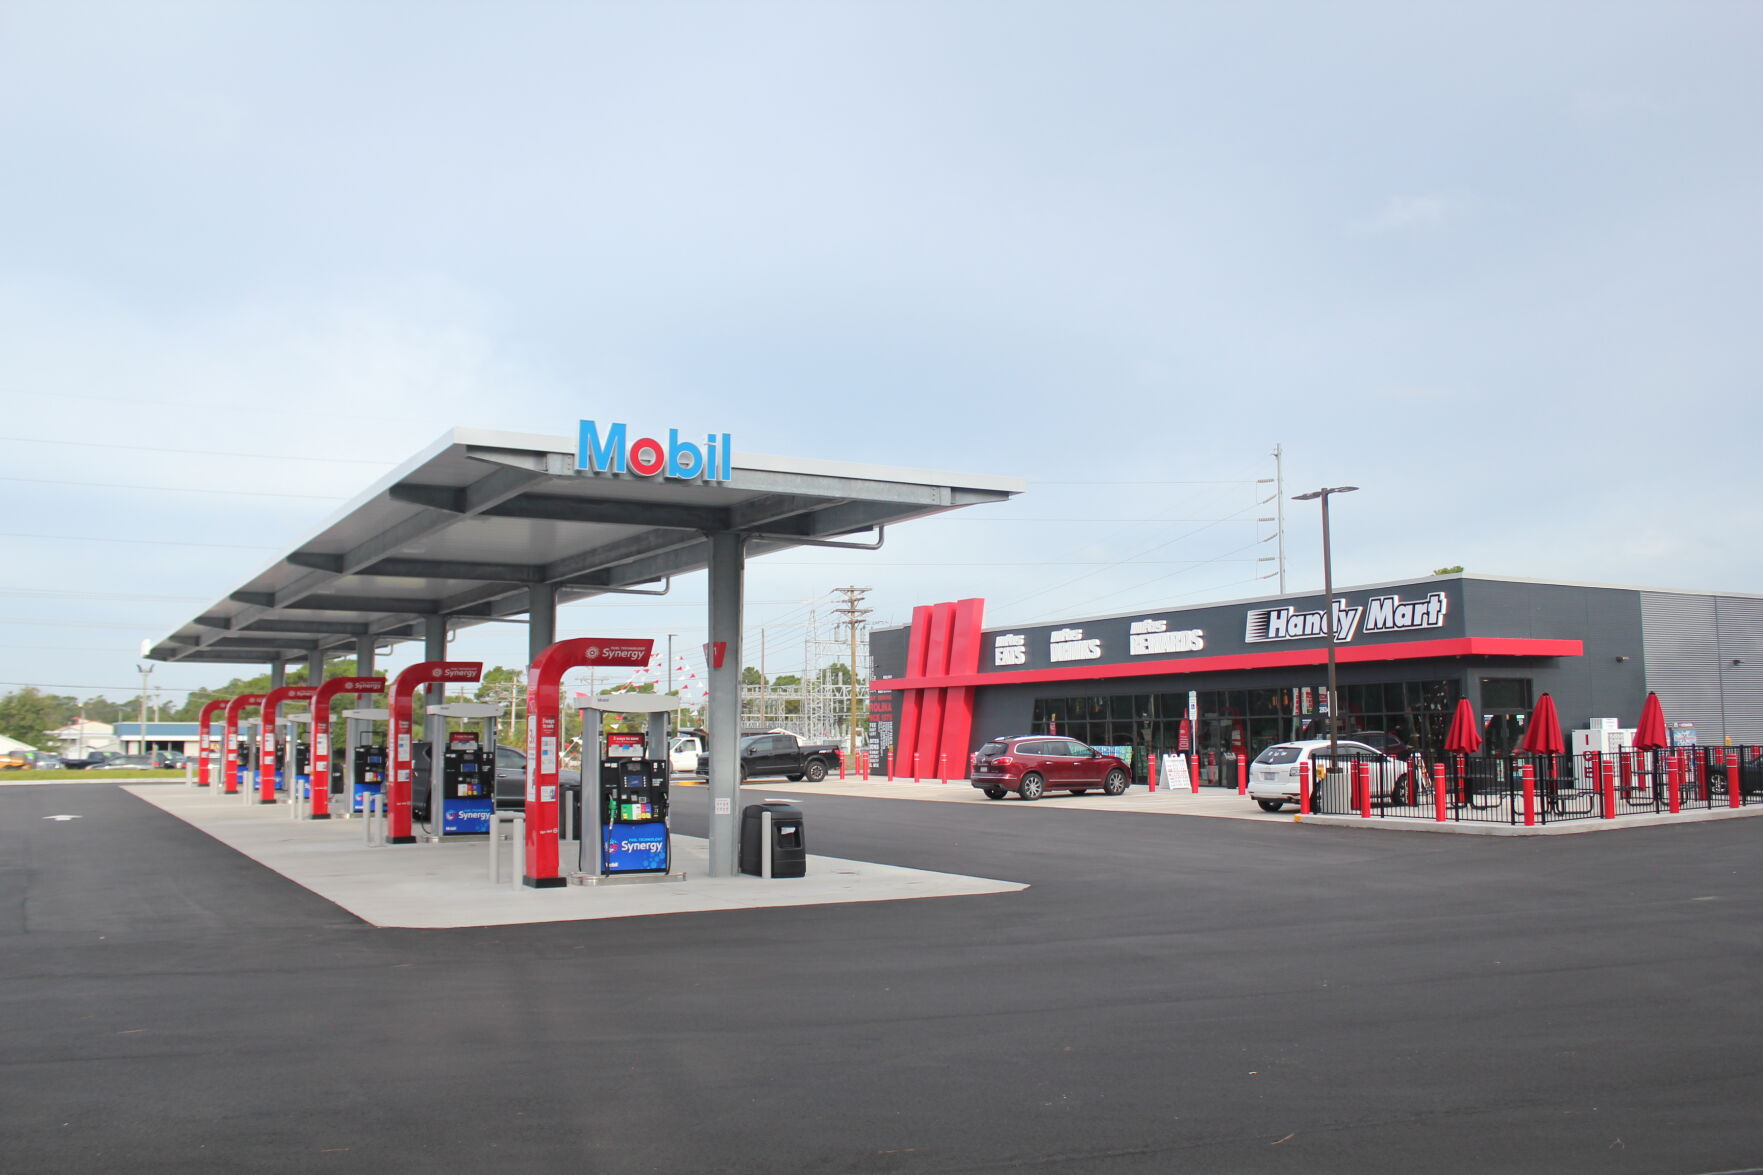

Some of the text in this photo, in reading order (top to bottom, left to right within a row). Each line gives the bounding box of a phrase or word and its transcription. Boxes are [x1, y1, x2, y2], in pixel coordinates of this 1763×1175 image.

[577, 419, 731, 481] Mobil
[1265, 592, 1447, 642] Handy Mart
[1130, 629, 1204, 655] REWARDS
[602, 648, 645, 660] Synergy
[995, 645, 1026, 666] EATS
[444, 669, 477, 678] Synergy
[458, 810, 490, 820] Synergy
[621, 840, 663, 853] Synergy
